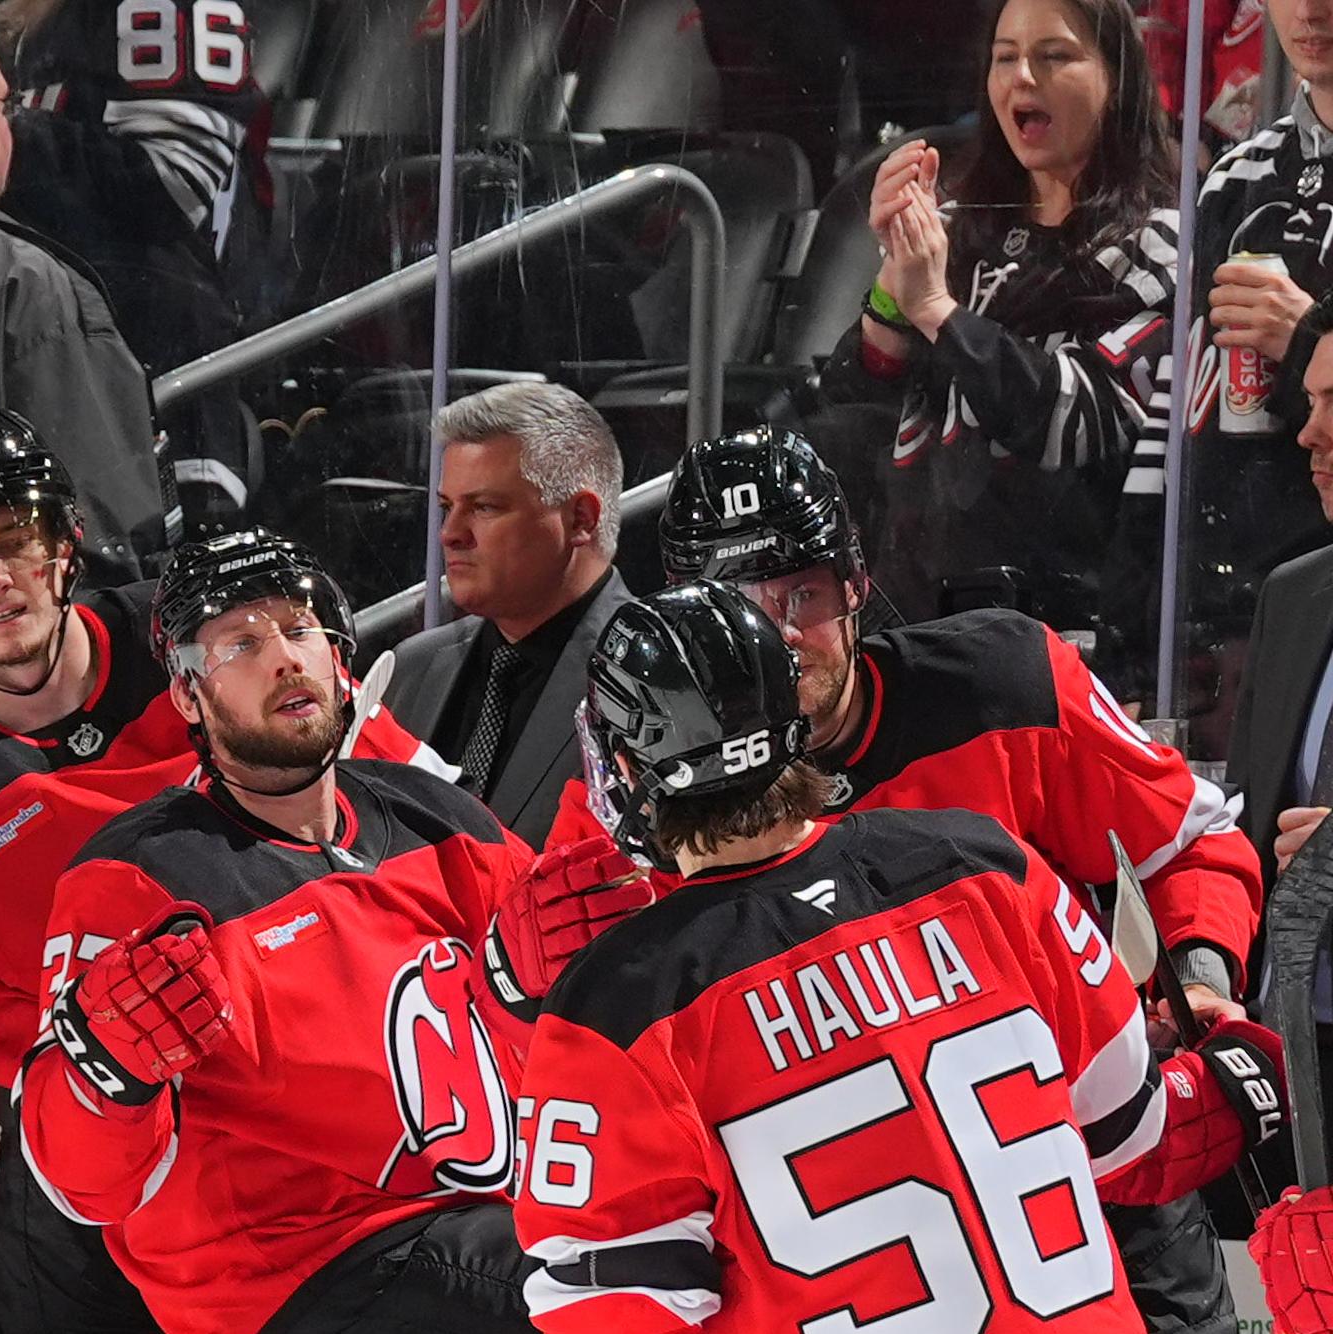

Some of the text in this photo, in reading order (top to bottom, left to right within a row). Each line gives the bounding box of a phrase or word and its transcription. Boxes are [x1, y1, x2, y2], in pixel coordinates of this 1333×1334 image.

[117, 0, 245, 86] 86
[721, 482, 760, 519] 10
[218, 552, 278, 573] BAUER
[716, 536, 777, 559] BAUER
[722, 729, 771, 775] 56
[744, 917, 981, 1071] HAULA
[1213, 1046, 1282, 1146] BAU
